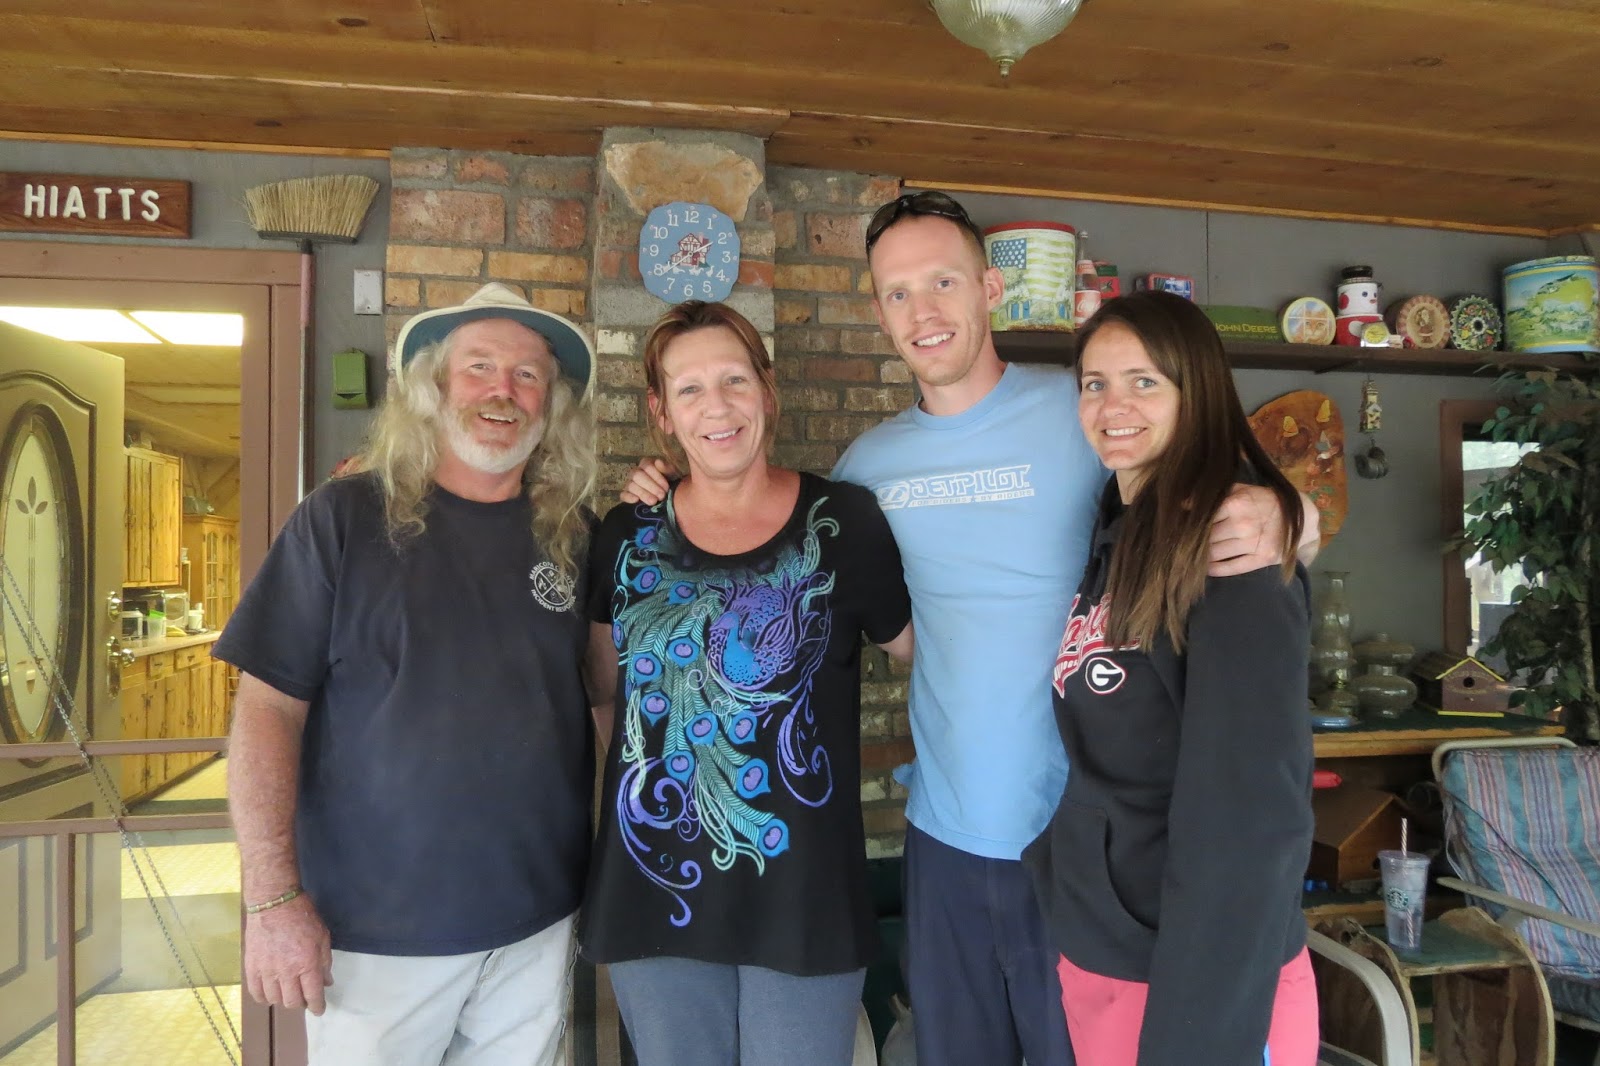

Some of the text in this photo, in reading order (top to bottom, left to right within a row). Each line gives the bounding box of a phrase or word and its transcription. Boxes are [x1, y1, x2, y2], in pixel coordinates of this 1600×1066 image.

[24, 183, 161, 222] HIATTS
[668, 214, 679, 227] 11
[684, 210, 700, 224] 12
[707, 218, 713, 230] 1
[654, 226, 668, 240] 10
[718, 232, 727, 245] 2
[649, 244, 659, 257] 9
[722, 251, 731, 264] 3
[653, 263, 664, 277] 8
[716, 269, 725, 282] 4
[667, 278, 675, 291] 7
[683, 284, 694, 297] 6
[703, 281, 712, 294] 5
[1215, 322, 1279, 334] JOHN DEERE
[910, 464, 1031, 498] JETPILOT
[932, 497, 968, 505] RIDERS
[997, 490, 1033, 500] RIDERS
[529, 561, 554, 580] MARICOPA
[531, 589, 555, 612] INCIDENT
[1089, 661, 1123, 689] G
